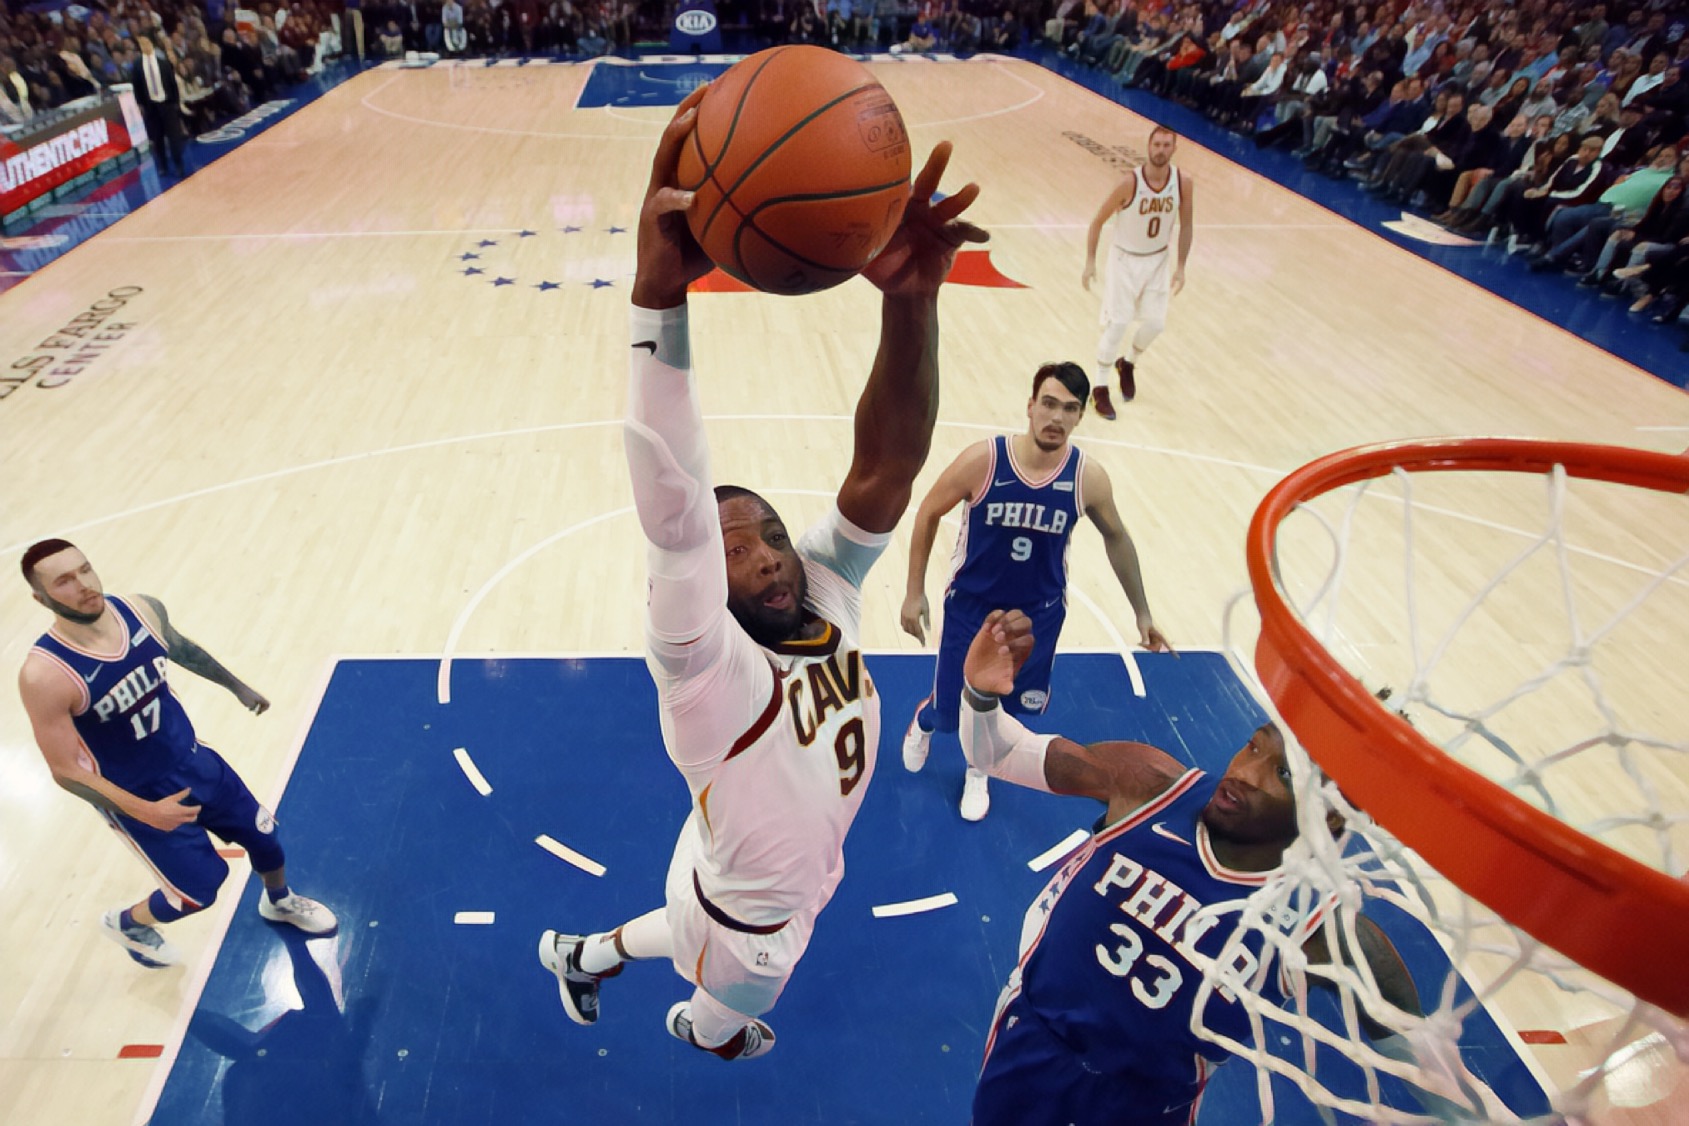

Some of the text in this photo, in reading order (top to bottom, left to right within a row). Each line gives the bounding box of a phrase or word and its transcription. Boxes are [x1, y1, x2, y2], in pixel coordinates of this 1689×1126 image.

[1139, 196, 1174, 215] CAVS
[1147, 216, 1161, 239] 0
[34, 286, 143, 350] FARGO
[36, 322, 138, 389] CENTER
[985, 502, 1068, 534] PHILA
[1010, 536, 1033, 562] 9
[130, 697, 160, 741] 17
[834, 716, 866, 797] 9
[1095, 922, 1184, 1010] 33
